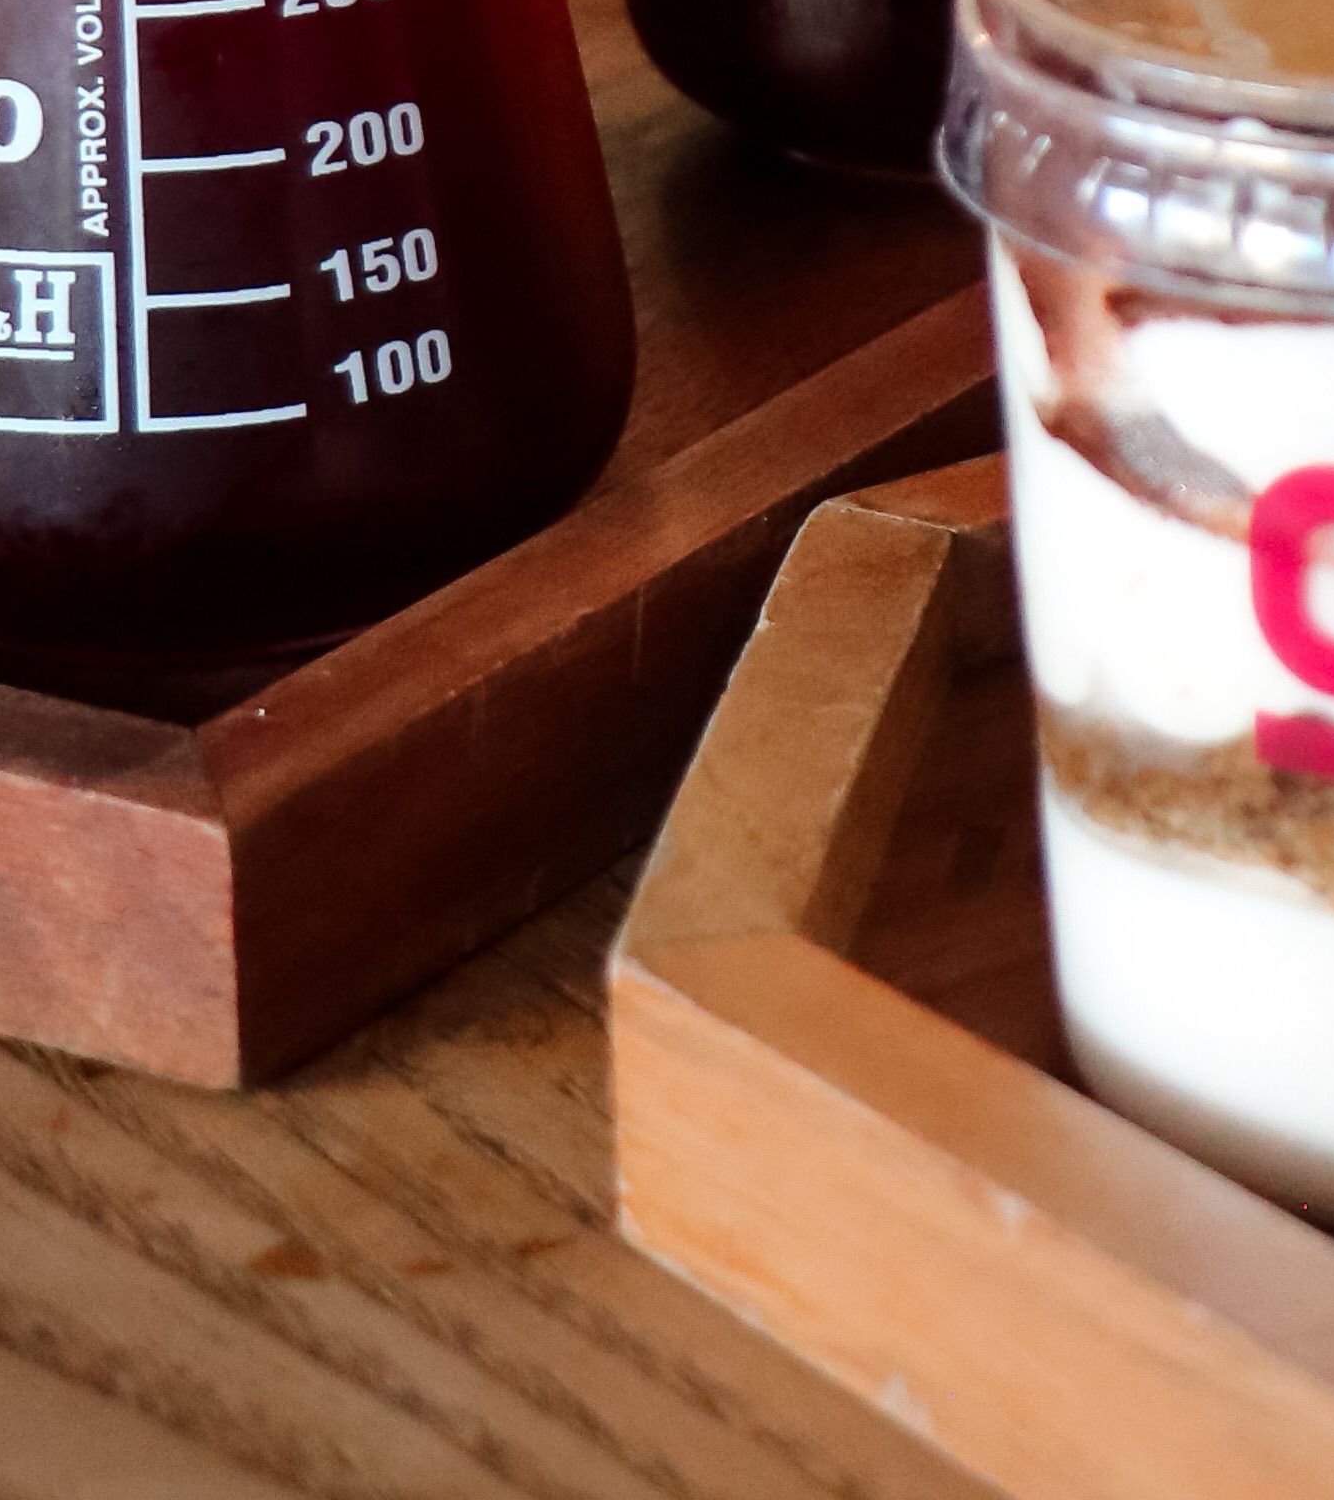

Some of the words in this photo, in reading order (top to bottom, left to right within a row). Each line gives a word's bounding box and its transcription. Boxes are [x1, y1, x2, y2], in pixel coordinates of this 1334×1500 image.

[79, 71, 109, 238] APPROX.
[304, 102, 424, 177] 200
[320, 227, 439, 303] 150
[334, 329, 452, 404] 100
